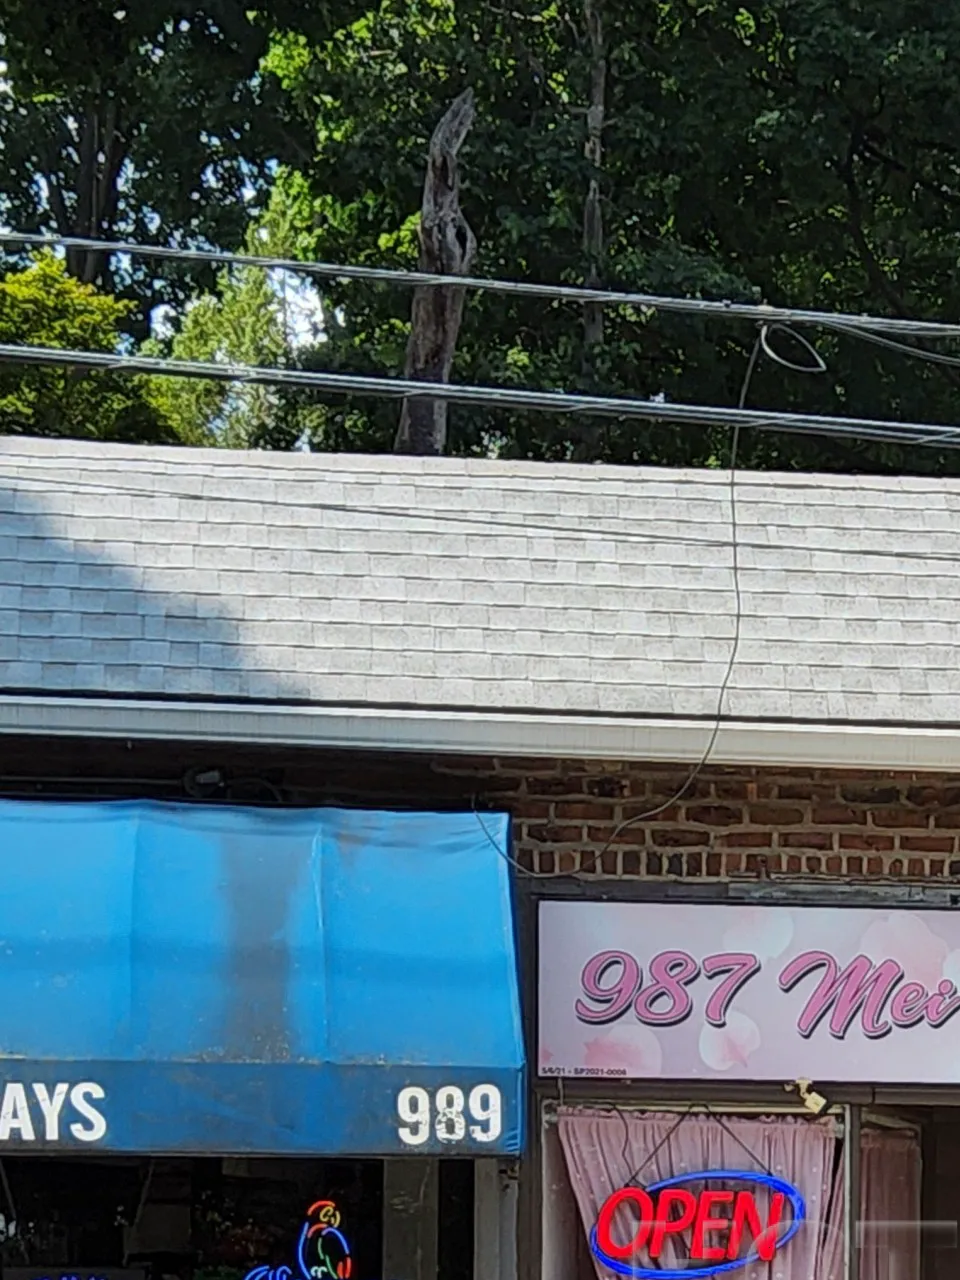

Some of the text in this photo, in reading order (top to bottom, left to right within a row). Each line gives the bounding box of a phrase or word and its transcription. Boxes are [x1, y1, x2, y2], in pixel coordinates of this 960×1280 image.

[575, 950, 760, 1028] 987
[397, 1083, 501, 1145] 989
[595, 1186, 785, 1263] OPEN
